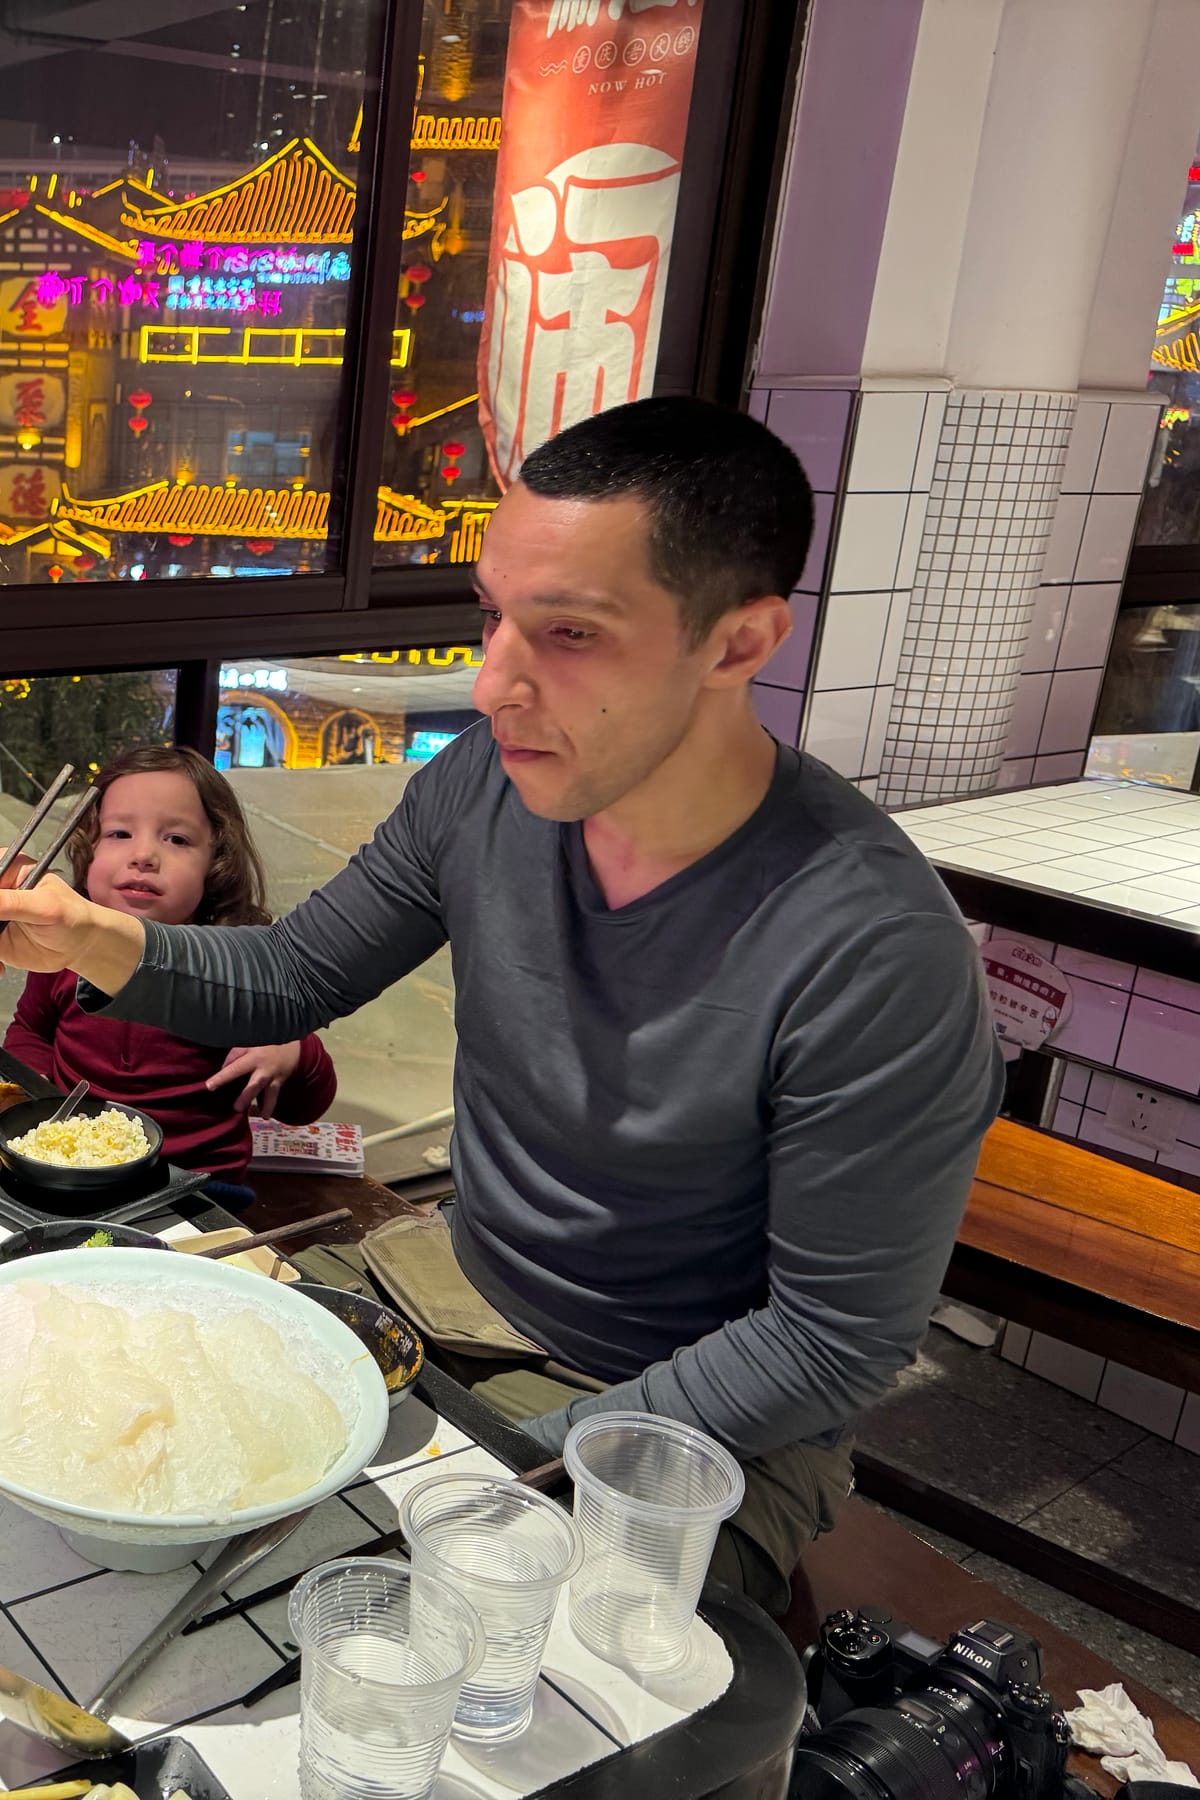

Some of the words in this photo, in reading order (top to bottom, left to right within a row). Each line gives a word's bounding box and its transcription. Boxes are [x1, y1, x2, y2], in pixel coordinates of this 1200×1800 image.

[588, 80, 627, 95] NOW
[635, 72, 667, 90] HOT
[953, 1643, 993, 1669] Nikon
